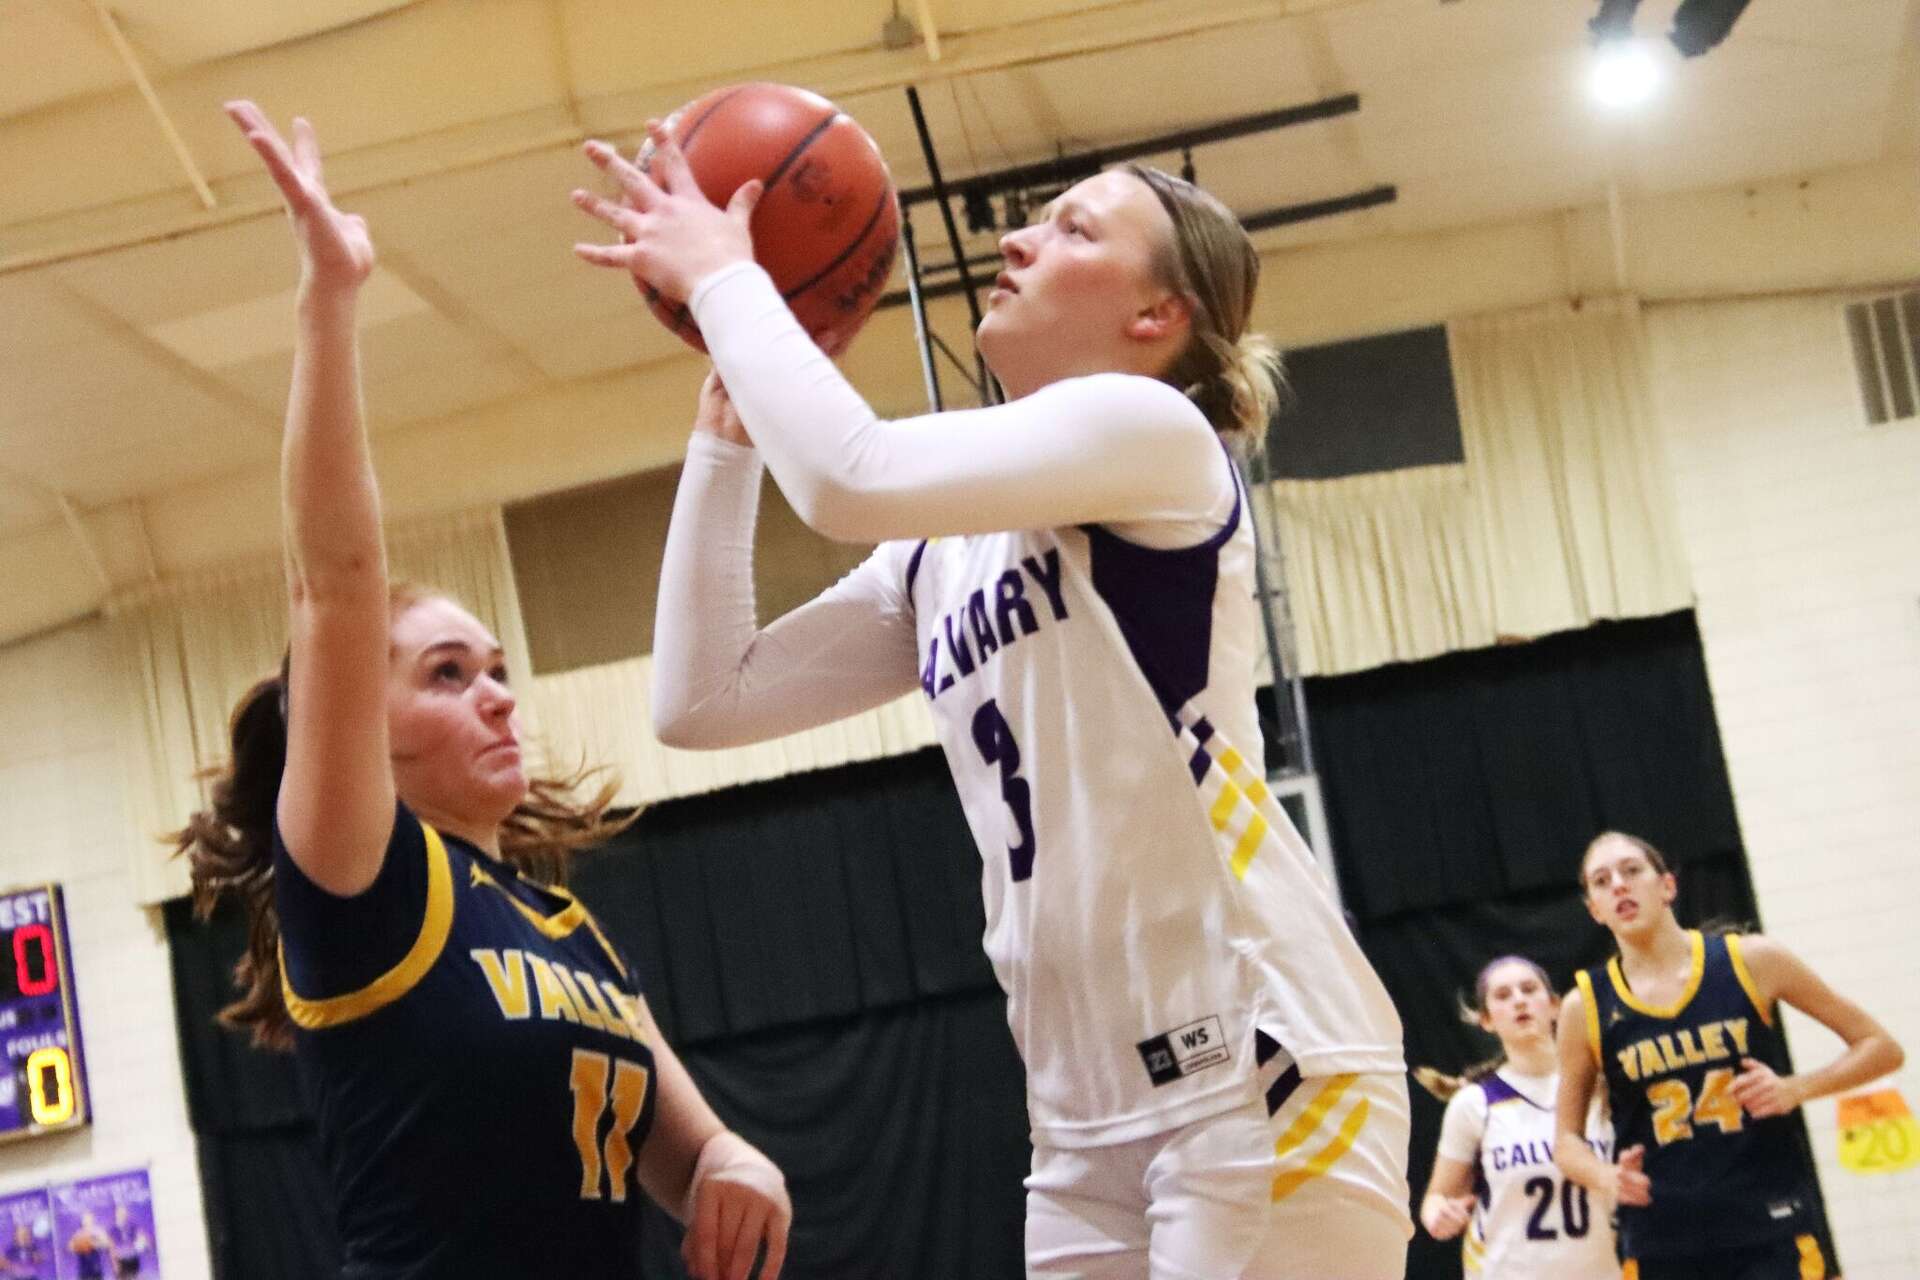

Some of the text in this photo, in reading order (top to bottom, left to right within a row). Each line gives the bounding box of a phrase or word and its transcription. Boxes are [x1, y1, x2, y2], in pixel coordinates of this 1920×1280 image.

[921, 546, 1070, 701] ALVARY
[971, 698, 1036, 882] 3
[13, 923, 58, 996] 0
[470, 948, 653, 1048] VALLE
[1180, 1027, 1209, 1050] WS
[1616, 1017, 1749, 1082] VALLEY
[27, 1046, 75, 1125] 0
[569, 1047, 649, 1203] 11
[1647, 1066, 1744, 1147] 24
[1524, 1175, 1590, 1240] 20
